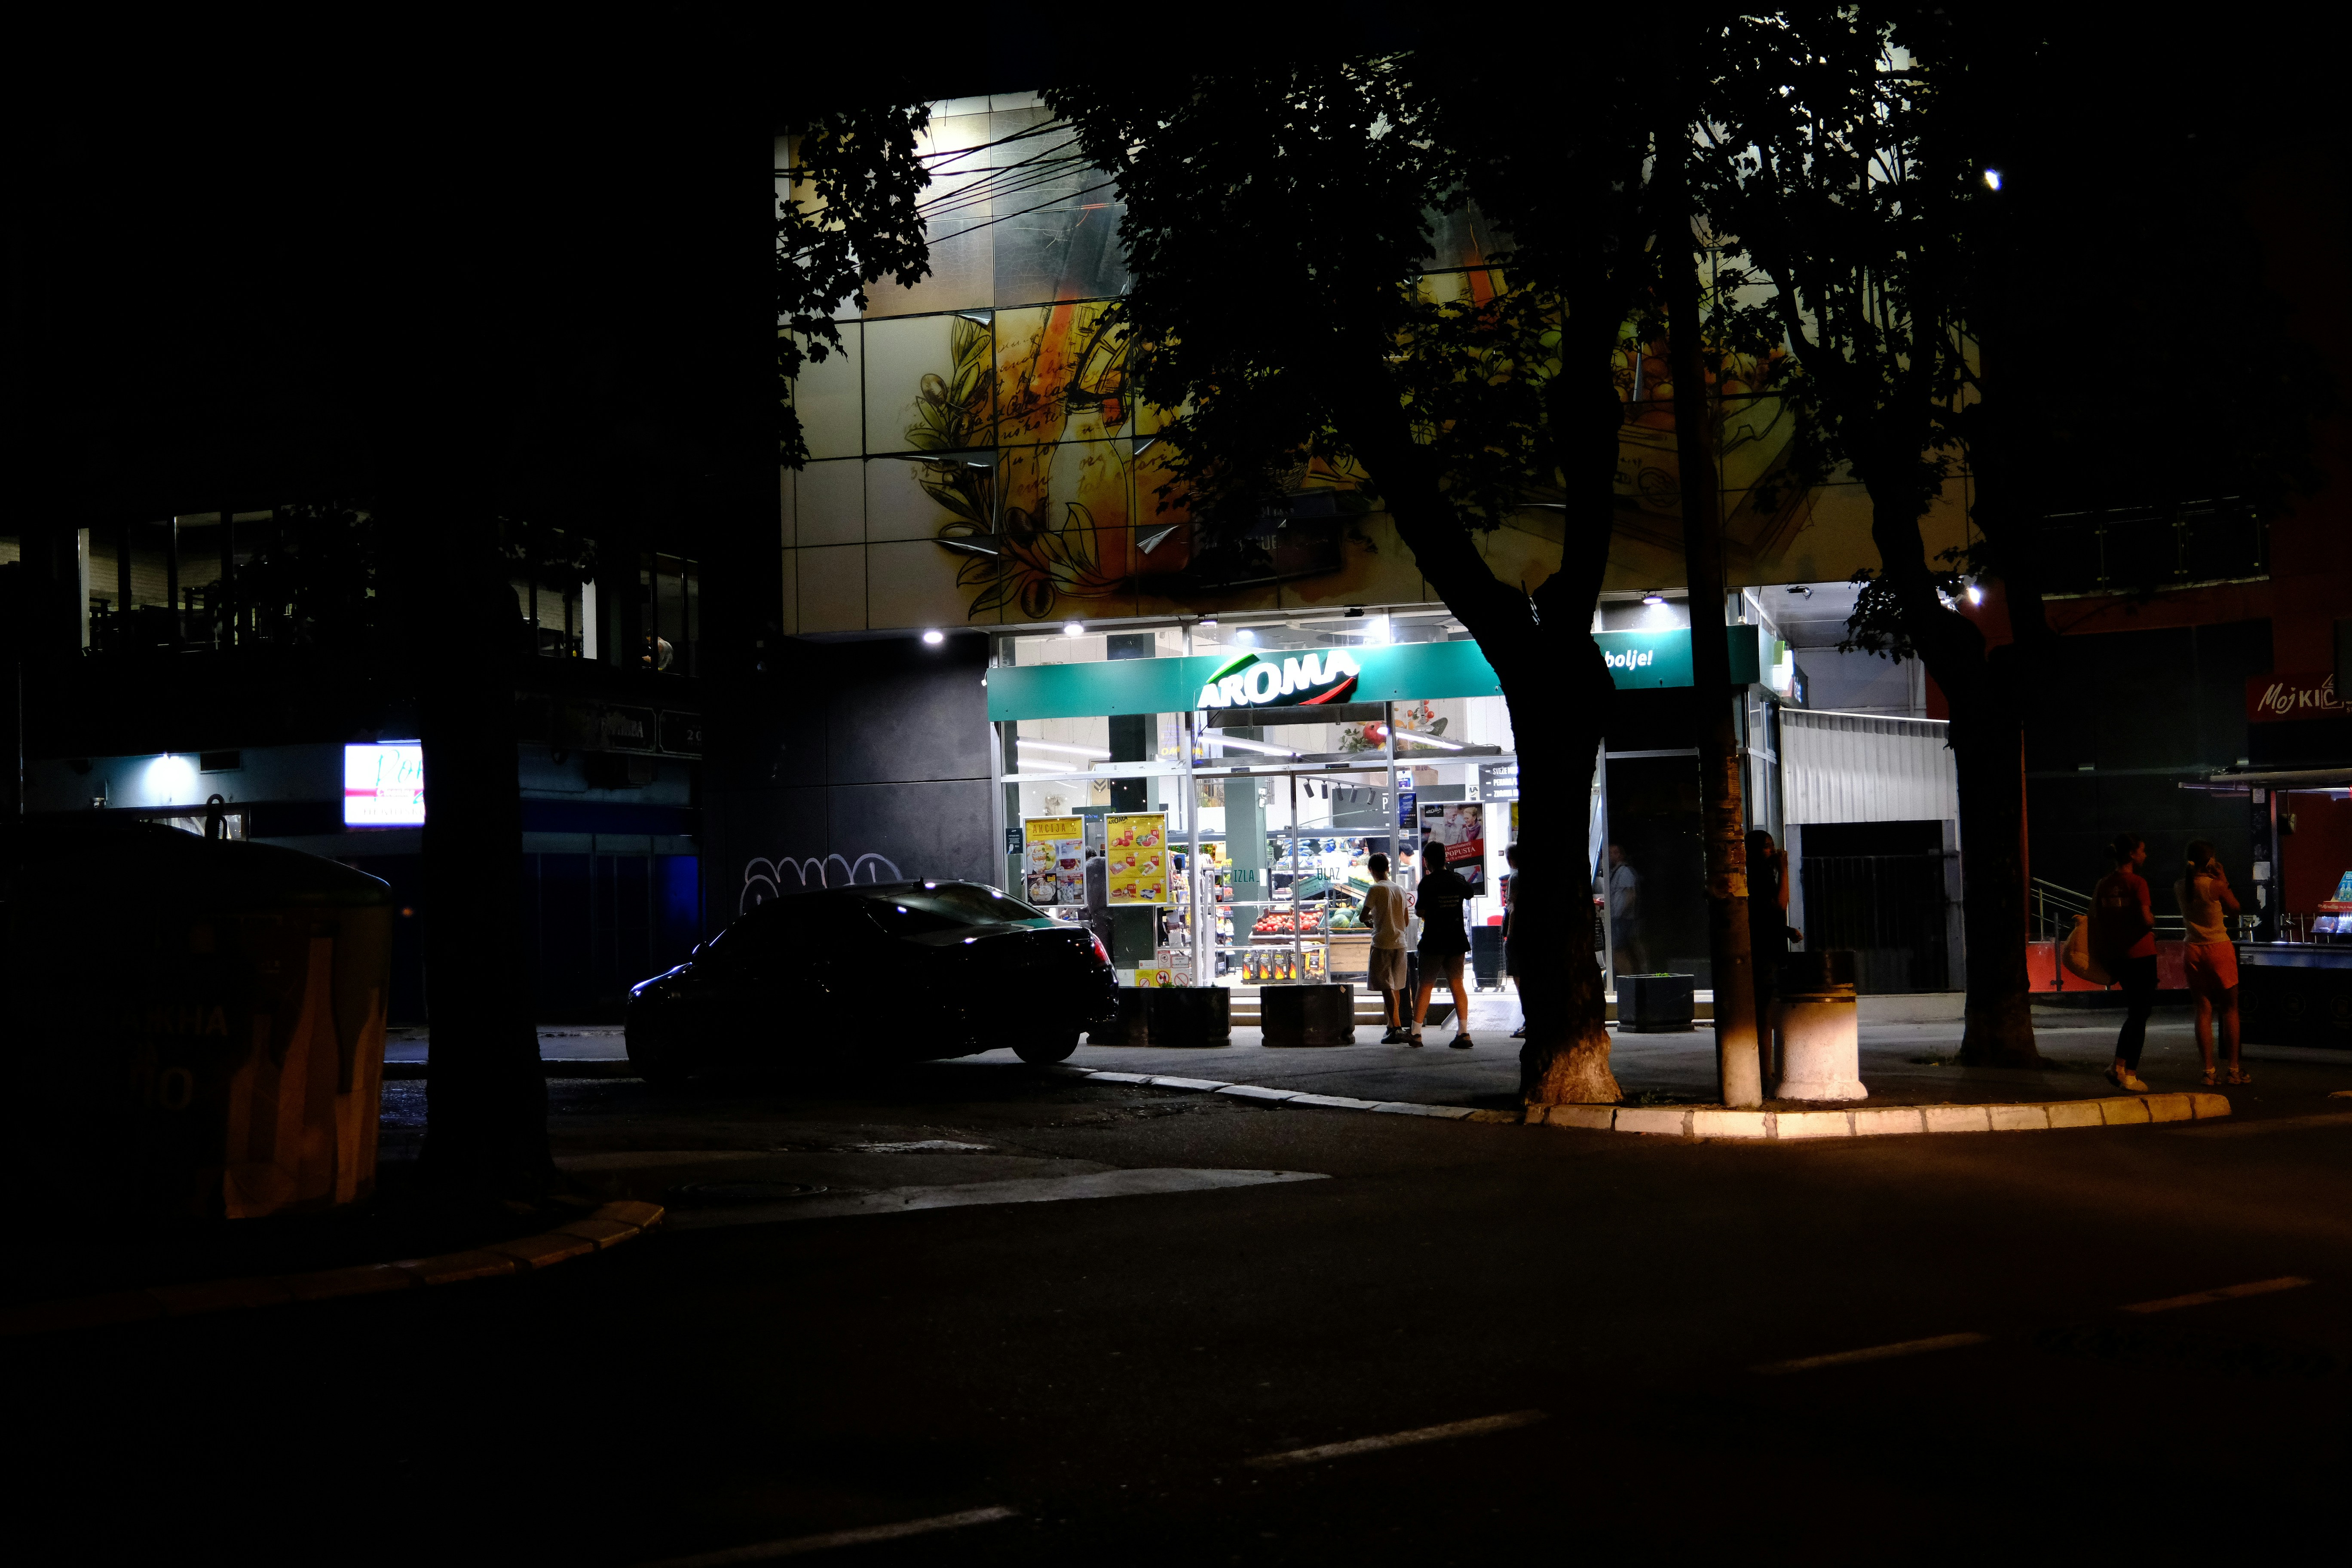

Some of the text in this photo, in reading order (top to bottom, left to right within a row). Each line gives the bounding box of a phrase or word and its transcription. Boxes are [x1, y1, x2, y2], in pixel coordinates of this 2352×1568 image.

[1605, 649, 1653, 671] bolje!
[1197, 649, 1361, 708] AROMA
[2257, 682, 2296, 714] Moj
[1109, 816, 1128, 824] AROMA
[1033, 824, 1066, 833] AKCIJA
[1445, 846, 1476, 858] POPUSTA
[1447, 842, 1471, 851] penzioneri!
[1234, 870, 1259, 882] IZLA
[1317, 867, 1340, 880] ULAZ
